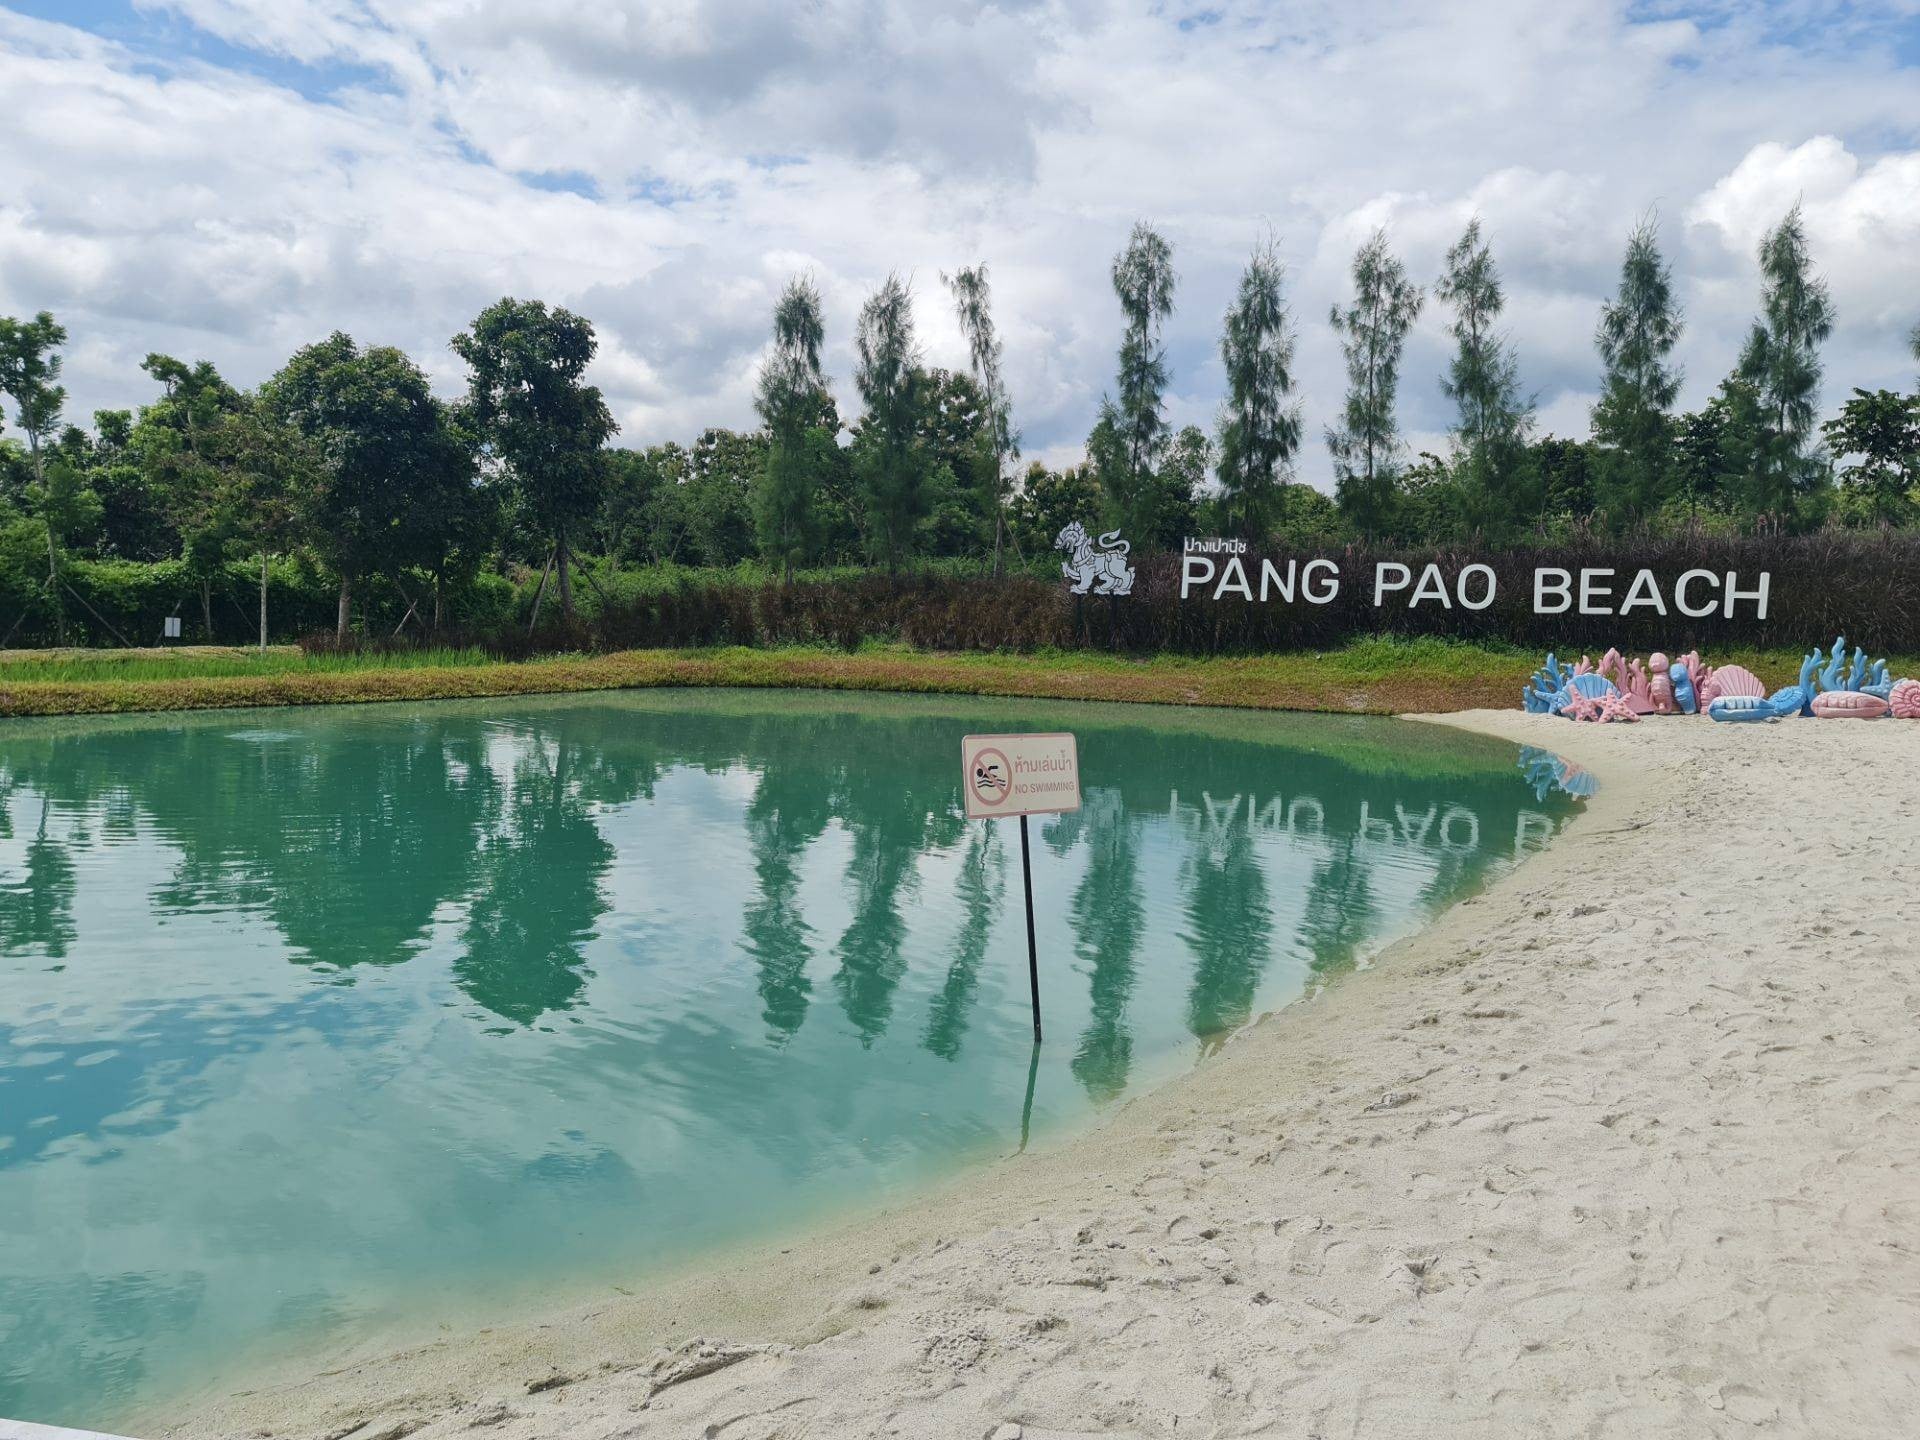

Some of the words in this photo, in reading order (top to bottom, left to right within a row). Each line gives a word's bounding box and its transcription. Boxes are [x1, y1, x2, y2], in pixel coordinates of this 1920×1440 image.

[1180, 556, 1340, 604] PANG
[1374, 562, 1497, 610] PAO
[1533, 567, 1770, 620] BEACH
[1015, 783, 1028, 794] NO
[1030, 781, 1075, 793] SWIMMING
